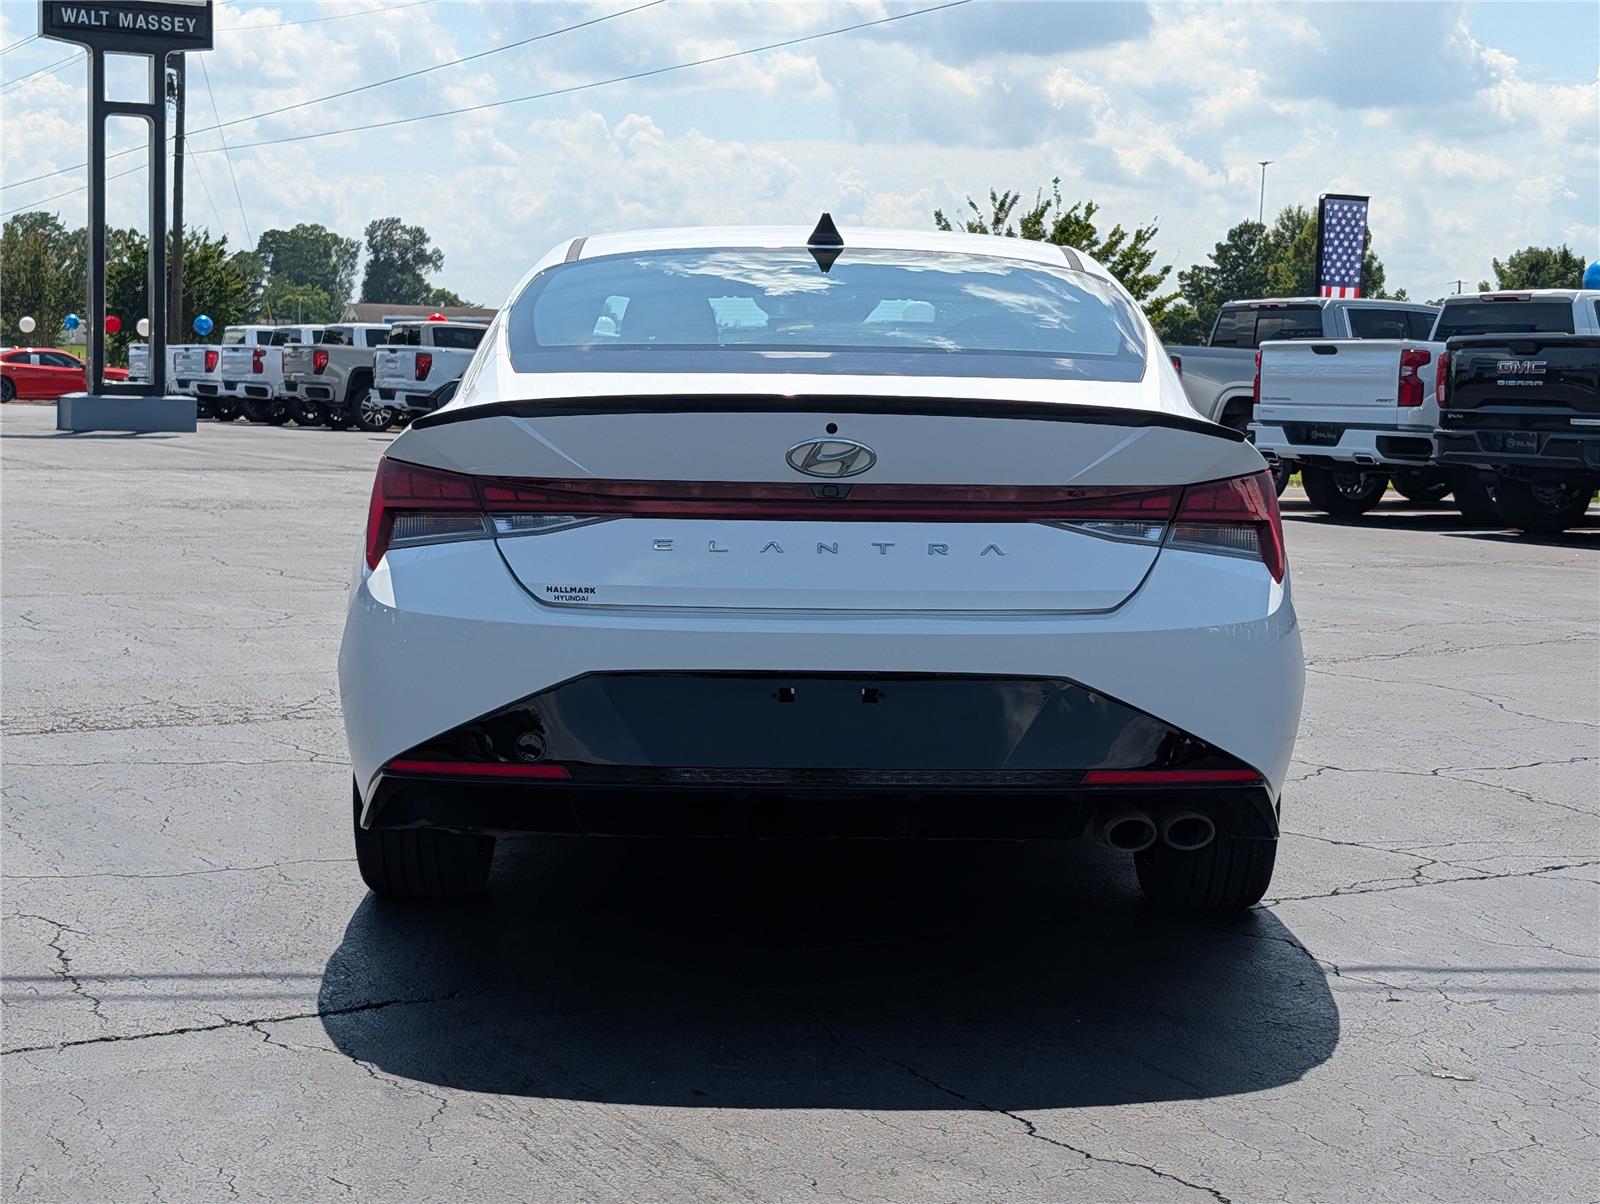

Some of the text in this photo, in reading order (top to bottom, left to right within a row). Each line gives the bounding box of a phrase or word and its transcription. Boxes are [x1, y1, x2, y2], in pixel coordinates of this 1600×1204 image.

[61, 7, 197, 33] WALT MASSEY
[1497, 360, 1547, 374] GMC
[652, 538, 1005, 556] ELANTRA
[546, 586, 596, 594] HALLMARK
[554, 594, 589, 602] HYUNDAI
